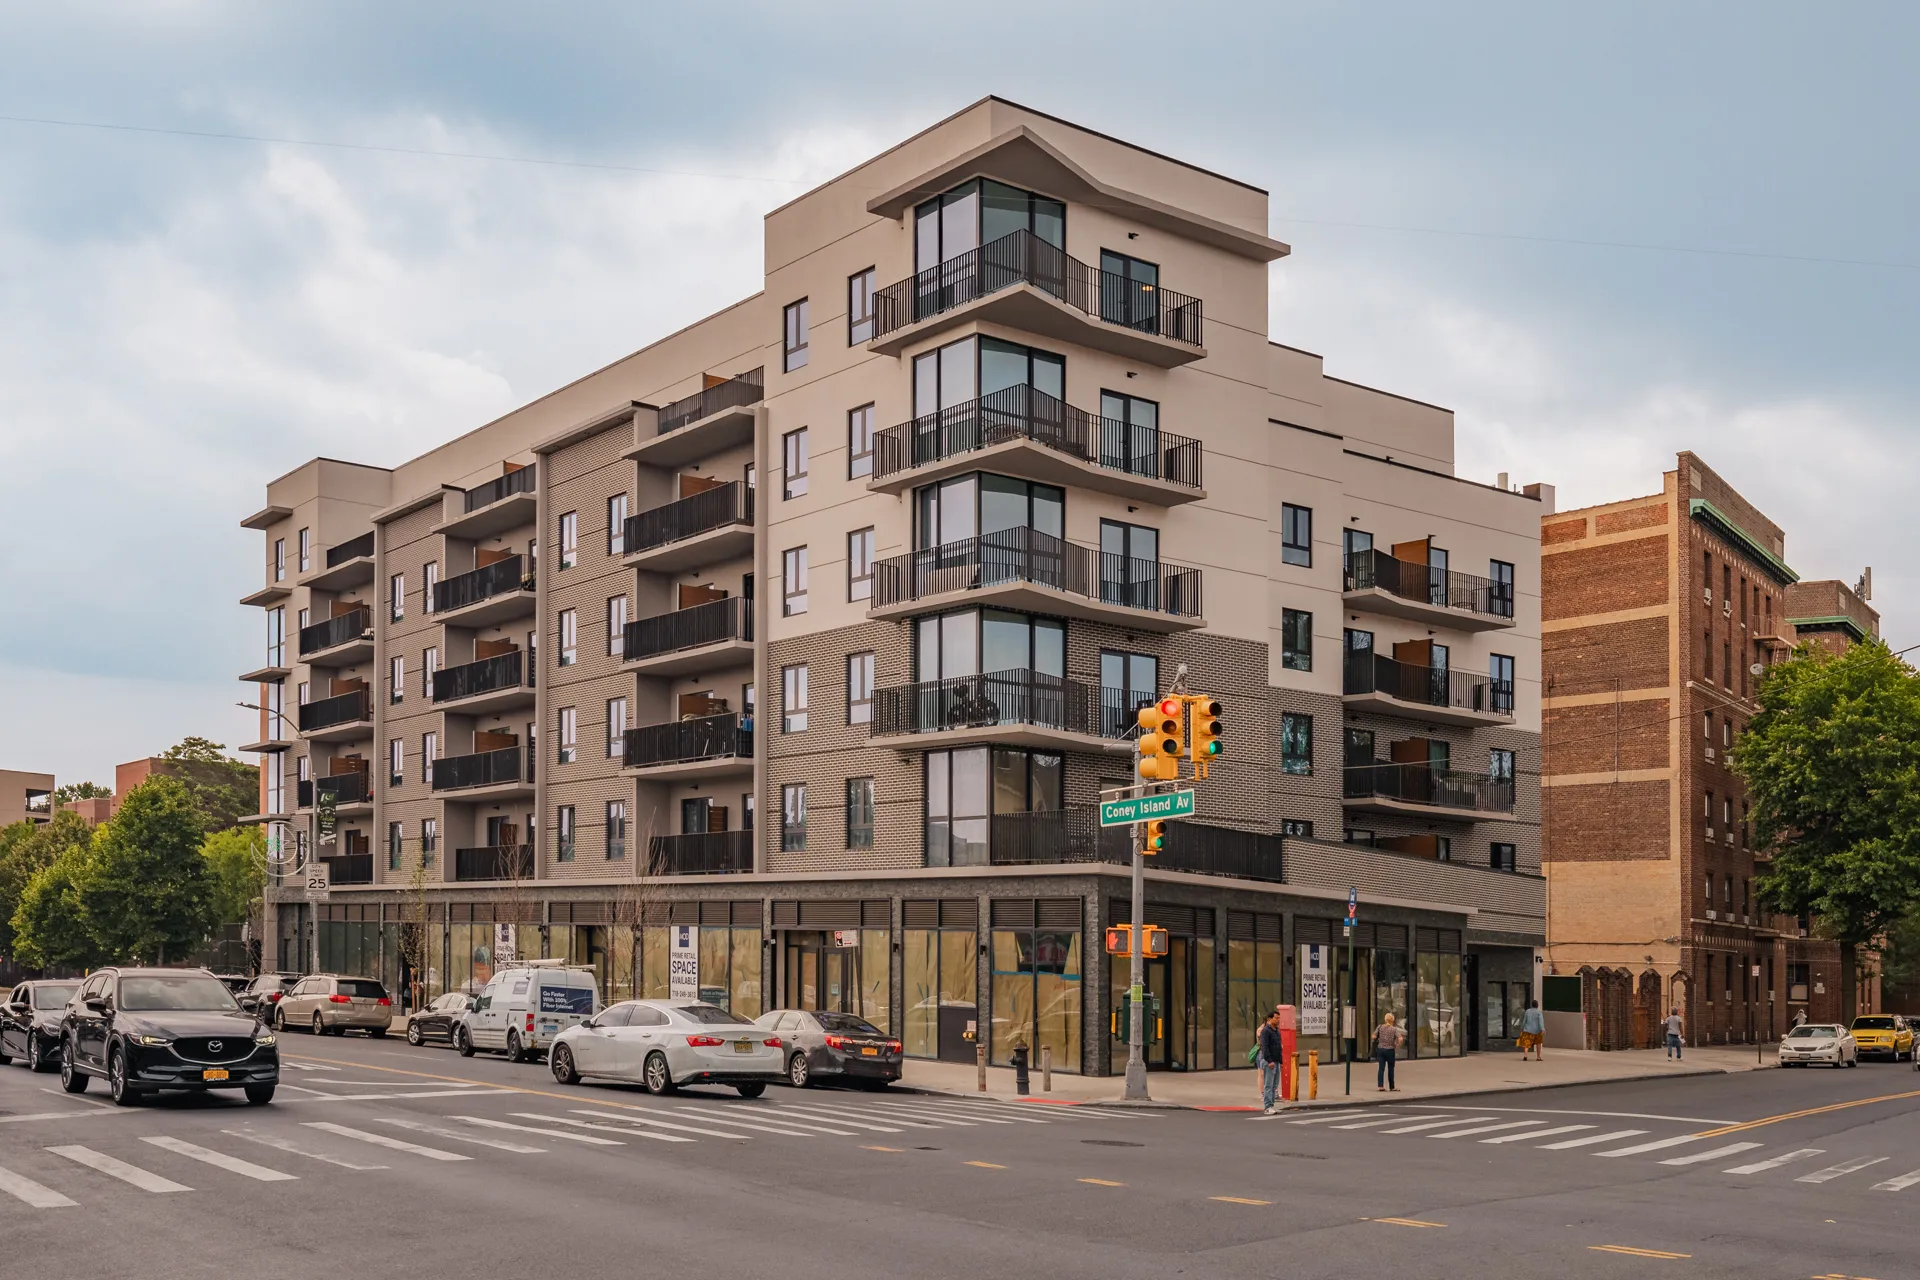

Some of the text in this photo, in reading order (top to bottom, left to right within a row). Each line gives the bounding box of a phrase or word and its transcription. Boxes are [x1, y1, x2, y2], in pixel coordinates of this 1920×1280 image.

[1106, 796, 1189, 818] Coney Island Av
[308, 878, 326, 889] 25
[684, 952, 696, 960] RETAIL
[672, 960, 696, 975] SPACE
[672, 976, 696, 985] AVAILABLE
[1303, 973, 1315, 981] PRIME
[1303, 983, 1326, 998] SPACE
[1303, 1000, 1326, 1010] AVAILABLE
